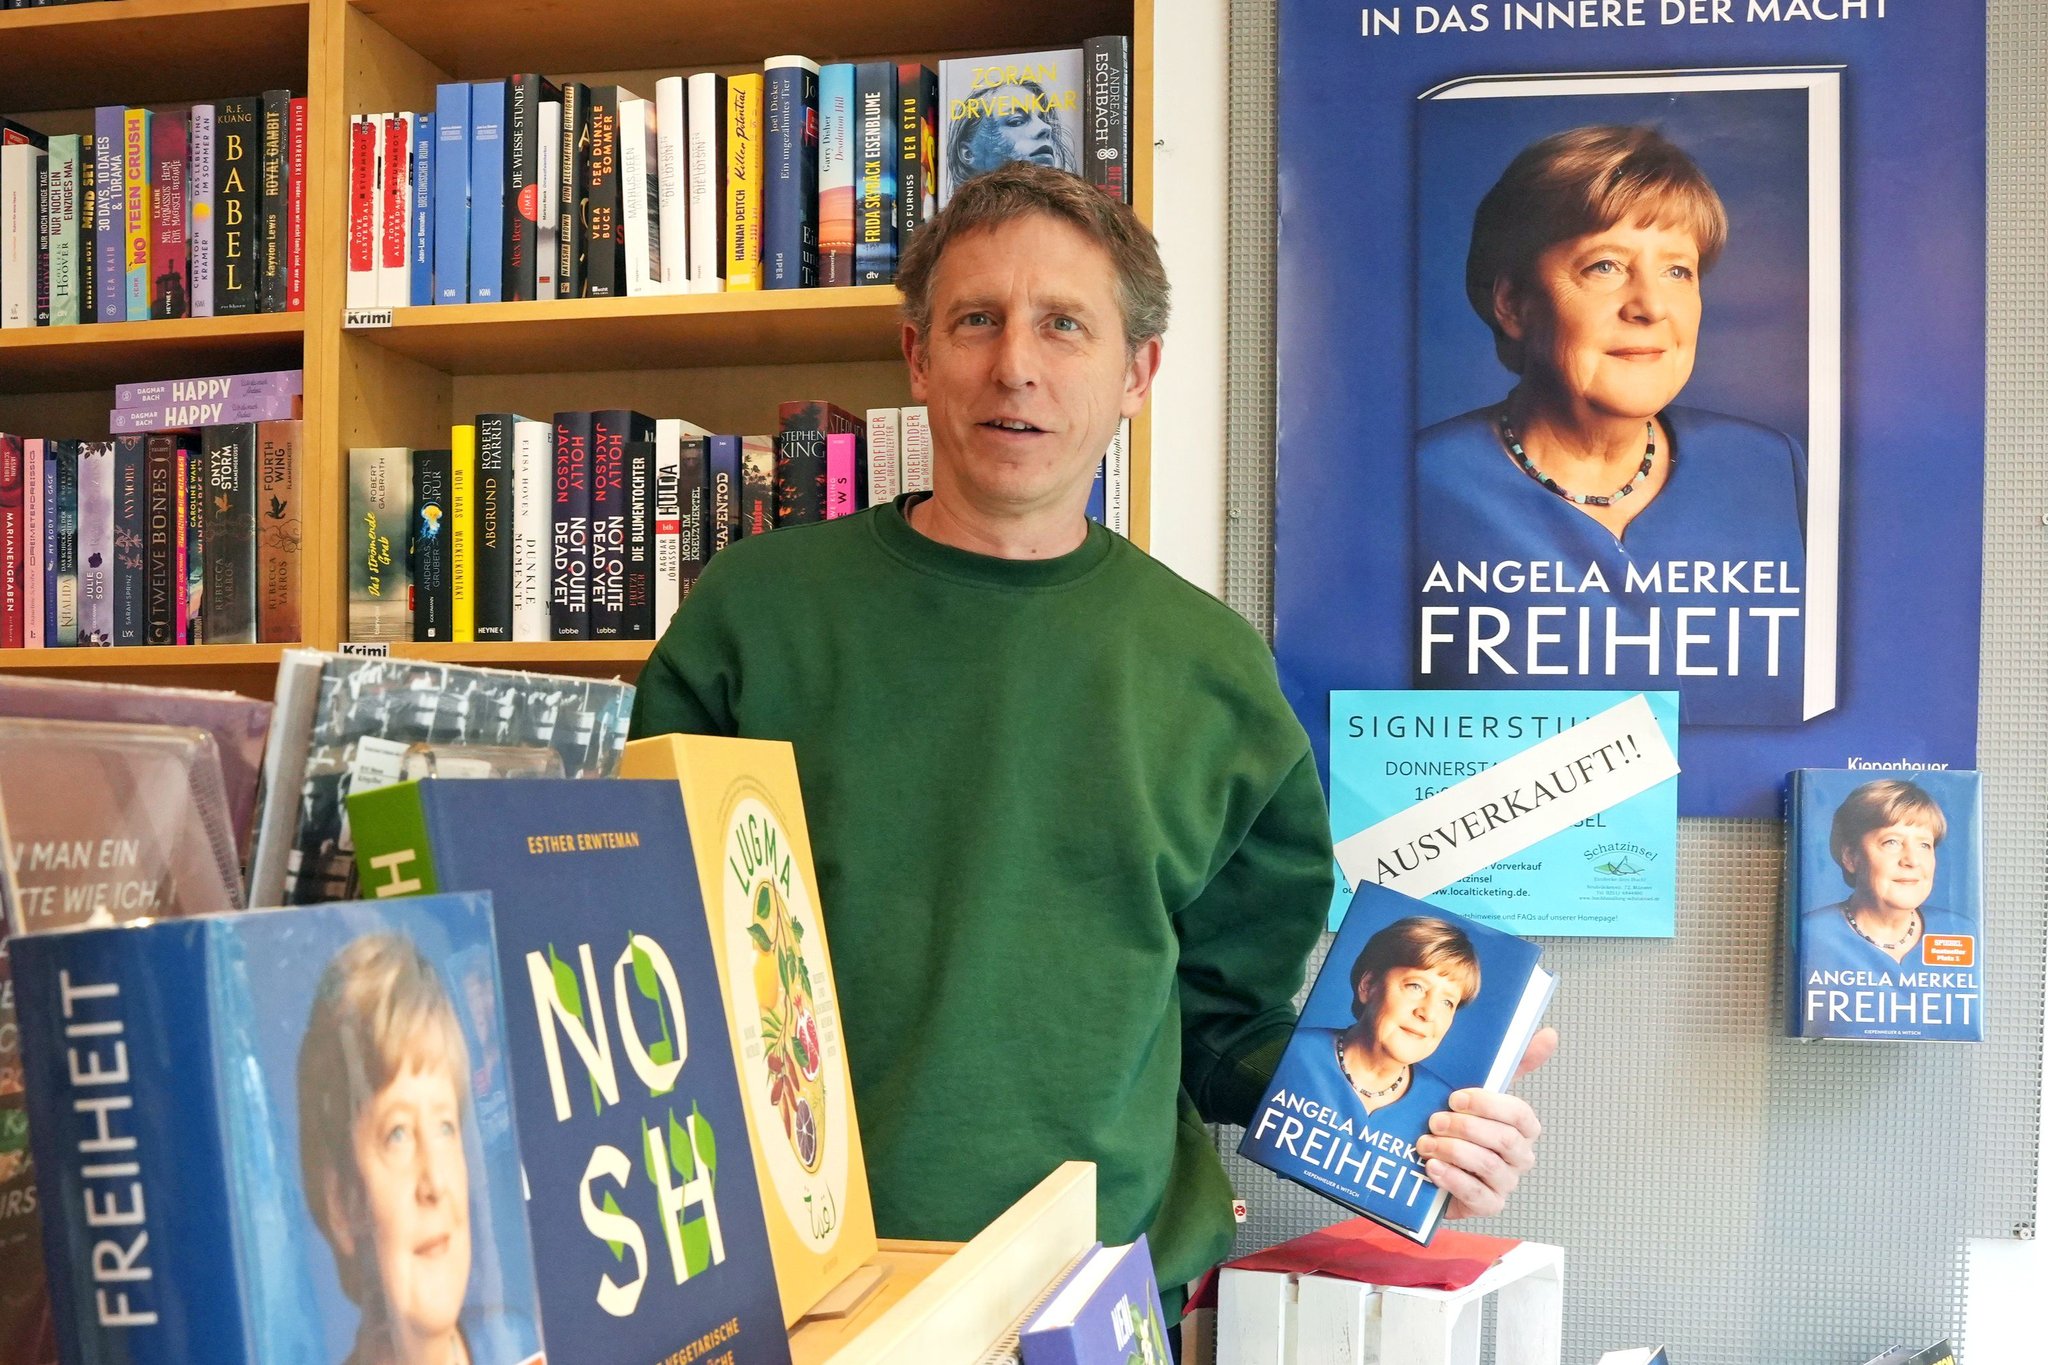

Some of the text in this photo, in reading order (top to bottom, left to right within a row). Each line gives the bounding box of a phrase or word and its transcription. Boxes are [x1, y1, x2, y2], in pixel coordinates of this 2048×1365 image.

[1362, 0, 1888, 36] IN DAS INNERE DER MACHT
[782, 79, 790, 97] Tier
[970, 62, 1057, 90] ZORAN
[1095, 52, 1109, 142] ESCHBACH
[1110, 68, 1120, 125] ANDREAS
[217, 113, 252, 124] KUANG
[835, 96, 844, 161] Desolation Hill
[864, 92, 880, 158] EISENBLUME
[950, 90, 1079, 120] DRVENKAR
[266, 111, 280, 156] GAMBIT
[592, 105, 603, 186] DER DUNKLE
[602, 115, 613, 174] SOMMER
[40, 170, 48, 187] TAGE
[110, 154, 122, 194] DRAMA
[266, 158, 279, 196] ROYAL
[511, 84, 524, 268] Alex Beer DIE WEISSE STUNDE
[732, 87, 751, 261] HANNAH DEITCH Killer Potential
[781, 160, 789, 180] Ein
[904, 98, 916, 232] JO FURNISS DER STAU
[40, 188, 48, 214] WENIGE
[51, 171, 61, 236] NUR NOCH EIN
[63, 158, 74, 221] EINZIGES MAL
[111, 202, 123, 211] &
[128, 119, 147, 265] NO TEEN CRUSH
[222, 134, 246, 290] BABEL
[40, 215, 48, 234] NOCH
[40, 235, 48, 250] NUR
[266, 214, 276, 239] Lewis
[592, 207, 601, 240] VERA
[602, 207, 611, 239] BUCK
[865, 211, 880, 242] FRIDA
[347, 311, 392, 325] Krimi
[172, 378, 232, 402] HAPPY
[165, 403, 223, 427] HAPPY
[780, 430, 826, 442] STEPHEN
[211, 450, 221, 486] ONYX
[221, 445, 232, 490] STORM
[264, 441, 273, 491] FOURTH
[275, 448, 285, 483] WING
[481, 420, 492, 470] ROBERT
[491, 419, 502, 470] HARRIS
[557, 424, 568, 503] JACKSON
[571, 436, 584, 490] HOLLY
[595, 423, 607, 502] JACKSON
[608, 435, 622, 489] HOLLY
[780, 441, 826, 459] KING
[485, 478, 497, 549] ABGRUND
[631, 457, 645, 562] DIE BLUMENTOCHTER
[658, 464, 678, 516] HULDA
[716, 472, 728, 552] HAFENTOD
[152, 468, 167, 615] TWELVE BONES
[662, 523, 674, 531] btb
[682, 513, 691, 562] MORD IM
[691, 487, 700, 561] KREUZVIERTEL
[6, 512, 15, 612] MARIANENGRABEN
[378, 535, 390, 565] Grab
[514, 533, 523, 611] MOMENTE
[526, 539, 536, 605] DUNKLE
[554, 522, 568, 605] DEAD YET
[569, 517, 586, 613] NOT QUITE
[593, 521, 606, 605] DEAD YET
[607, 516, 624, 612] NOT QUITE
[659, 539, 667, 572] RAGNAR
[86, 571, 94, 599] JULIE
[1421, 560, 1800, 594] ANGELA MERKEL
[61, 578, 73, 628] KHALIDA
[122, 630, 134, 638] LYX
[343, 645, 388, 657] Krimi
[1420, 606, 1800, 677] FREIHEIT
[1349, 715, 1590, 739] SIGNIERSTU
[1385, 761, 1498, 777] DONNERST
[1377, 734, 1642, 884] AUSVERKAUFT!!
[30, 839, 140, 871] MAN EIN
[526, 831, 640, 854] ESTHER ERWTEMAN
[729, 814, 790, 900] LUGMA
[1584, 842, 1658, 861] Schatzinsel
[1491, 862, 1542, 871] Vorverkauf
[1808, 970, 1978, 989] ANGELA MERKEL
[526, 932, 688, 1122] NO
[1807, 990, 1979, 1025] FREIHEIT
[1271, 1089, 1354, 1136] ANGELA
[59, 968, 158, 1327] FREIHEIT
[1254, 1107, 1434, 1207] FREIHEIT
[1303, 1169, 1337, 1188] KIEPENHEUER
[1340, 1185, 1360, 1198] WITSCH
[579, 1100, 726, 1318] SH
